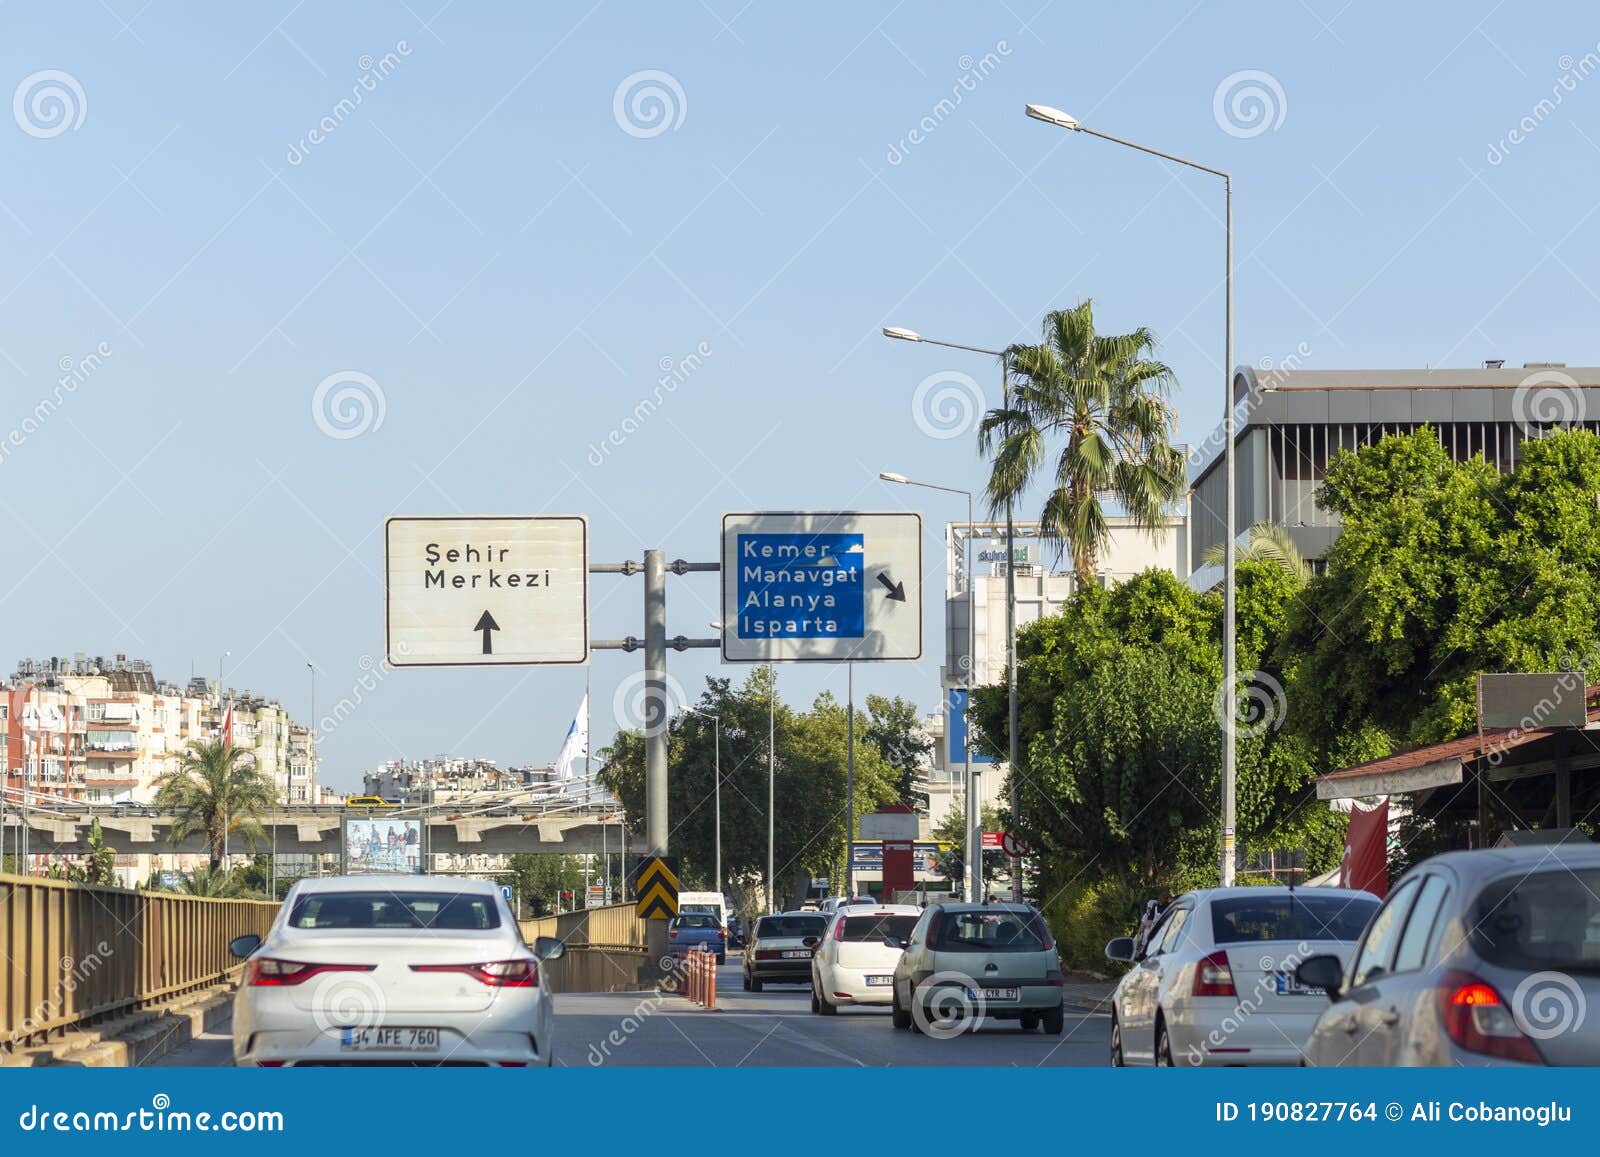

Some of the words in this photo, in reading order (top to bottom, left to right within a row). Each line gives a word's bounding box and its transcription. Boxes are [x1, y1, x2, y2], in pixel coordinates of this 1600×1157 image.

[425, 543, 510, 566] Şehir
[744, 540, 830, 558] Kemer
[424, 568, 550, 589] Merkezi
[744, 566, 857, 587] Manavgat
[744, 591, 836, 612] Alanya
[744, 616, 838, 637] Isparta
[353, 1030, 369, 1044] 34
[377, 1029, 402, 1045] AFE
[409, 1030, 435, 1045] 760
